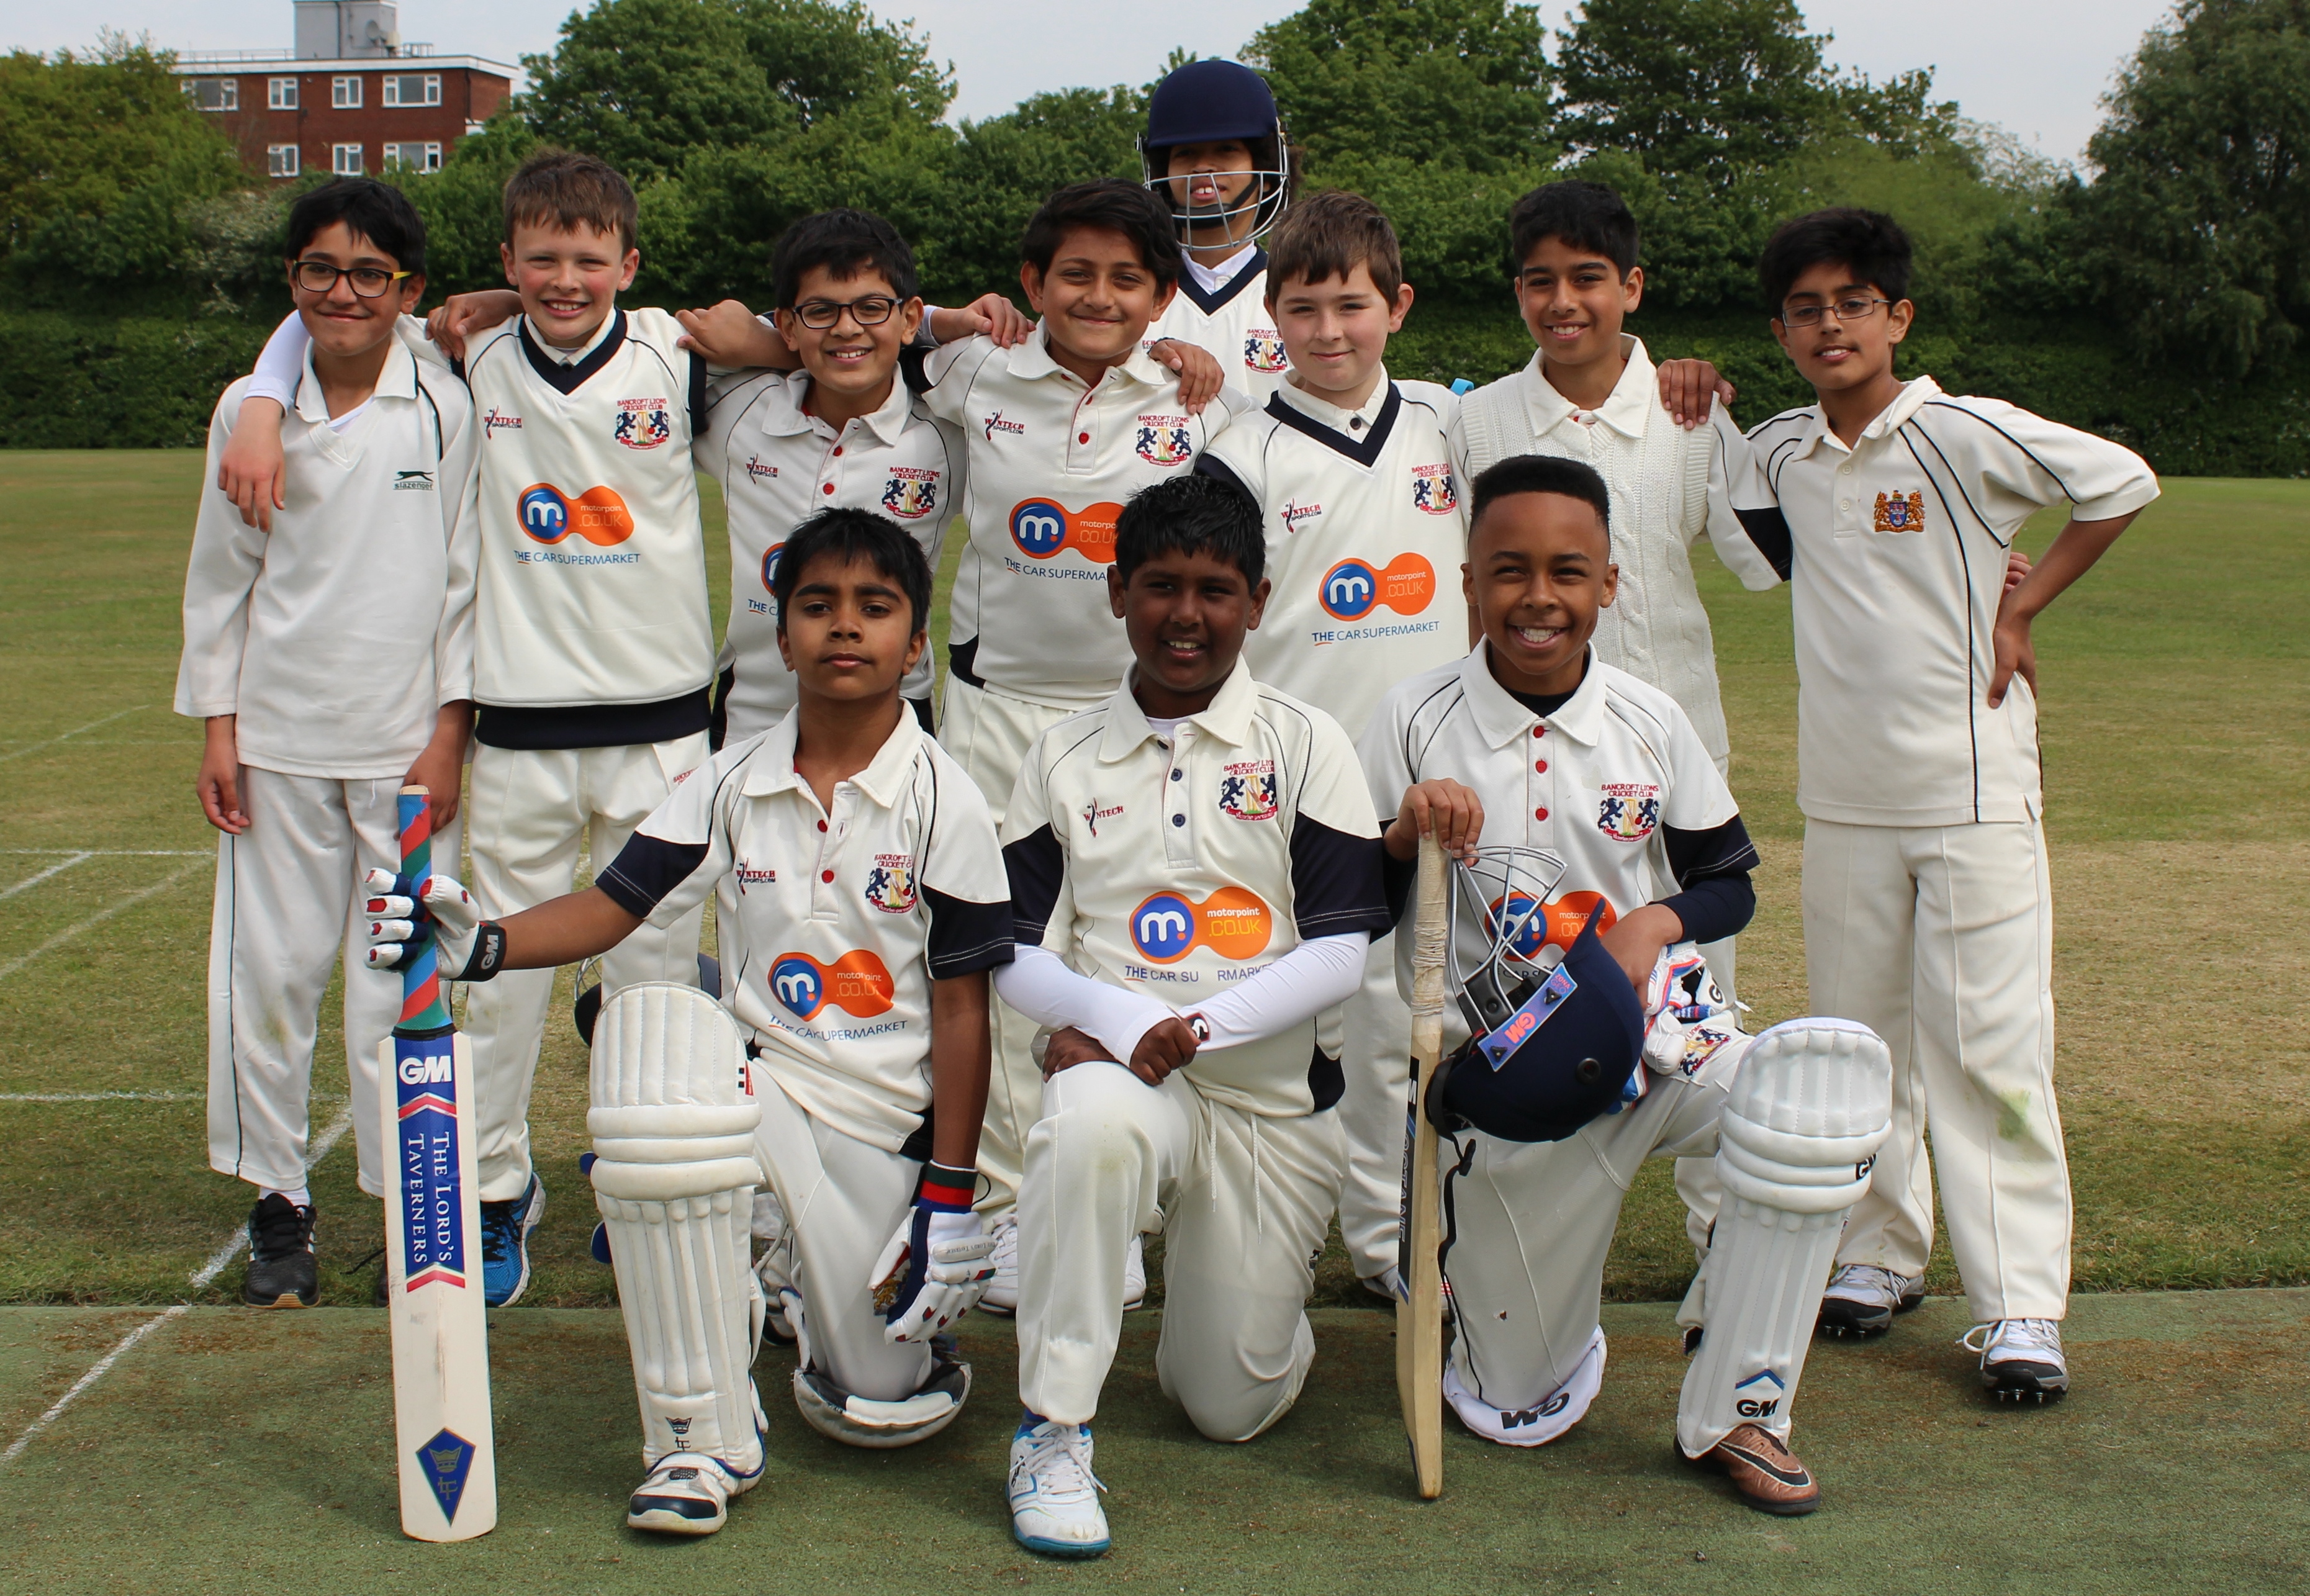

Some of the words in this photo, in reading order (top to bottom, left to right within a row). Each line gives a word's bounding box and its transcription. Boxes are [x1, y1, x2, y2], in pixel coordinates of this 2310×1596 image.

[889, 467, 923, 475] BANCROFT
[923, 469, 941, 478] LIONS
[1411, 464, 1438, 473] BANCROFT
[1417, 470, 1438, 478] CRICKET
[394, 482, 433, 490] slazenger
[514, 550, 531, 562] THE
[1004, 557, 1021, 572] THE
[1023, 565, 1047, 578] CAR
[1048, 568, 1107, 581] SUPERMA
[1387, 571, 1427, 582] motorpoint
[1386, 581, 1425, 598] .CO.UK
[748, 598, 767, 613] THE
[1312, 631, 1334, 642] THE
[1337, 629, 1365, 641] CAR
[1363, 621, 1440, 638] SUPERMARKET
[1224, 760, 1260, 772] BANCROFT
[1230, 768, 1258, 776] CRICKET
[1207, 907, 1260, 918] motorpoint
[1209, 919, 1263, 937] .CO.UK
[480, 934, 499, 970] GM
[1125, 965, 1148, 979] THE
[1150, 970, 1177, 981] CAR
[1504, 1012, 1536, 1044] GM
[399, 1055, 453, 1085] GM
[433, 1131, 450, 1176] THE
[407, 1132, 428, 1264] TAVERNERS
[436, 1184, 454, 1262] LORD'S
[1501, 1392, 1570, 1430] GM
[1736, 1398, 1780, 1418] GM
